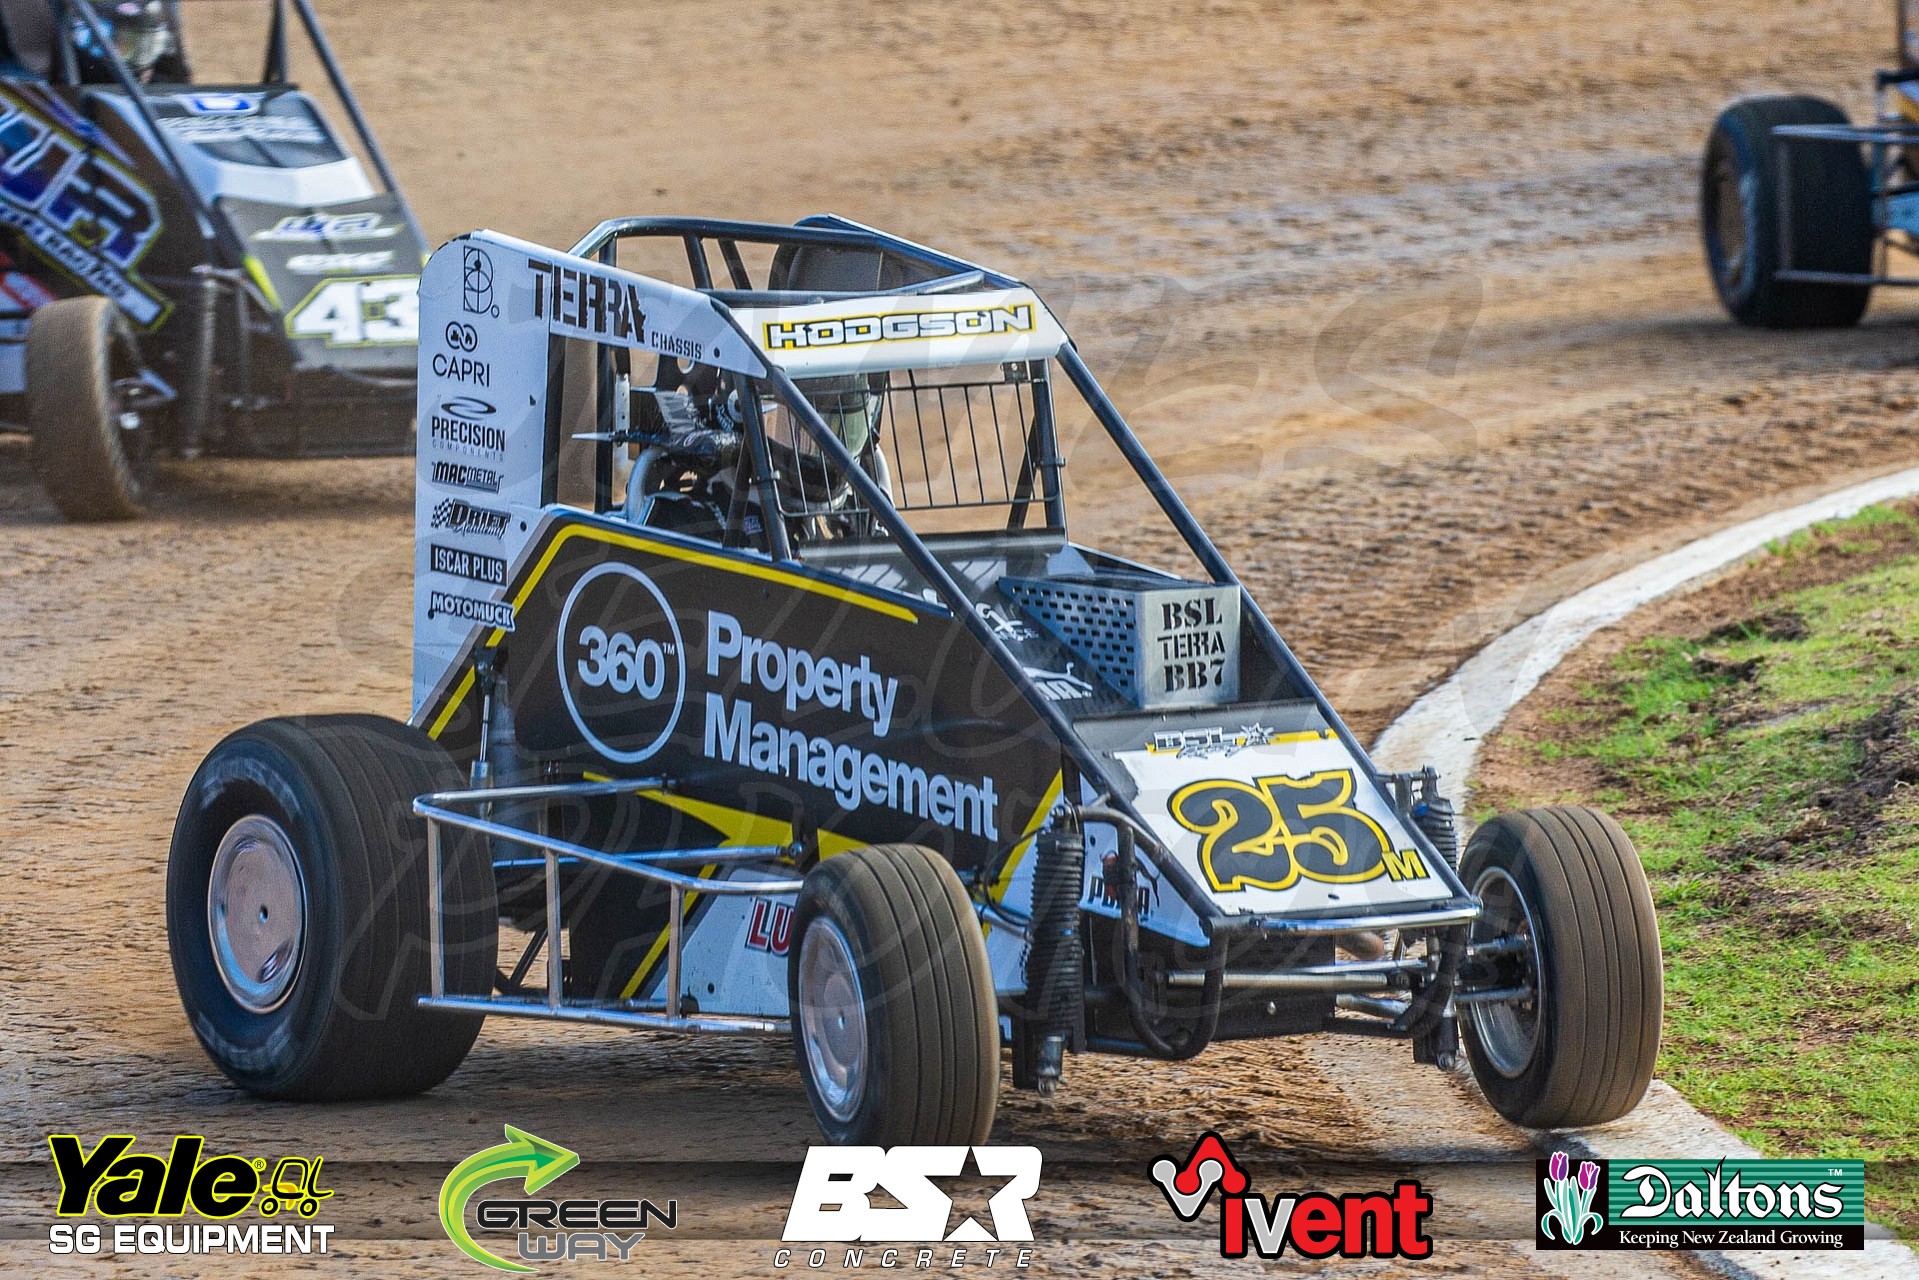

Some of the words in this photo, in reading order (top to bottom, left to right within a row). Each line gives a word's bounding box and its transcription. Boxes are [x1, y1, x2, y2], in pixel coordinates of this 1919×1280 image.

[287, 276, 419, 346] 43
[528, 258, 646, 343] TERRA
[651, 331, 703, 361] CHASSIS
[765, 304, 1034, 351] HODGSON
[432, 353, 491, 388] CAPRI
[431, 416, 506, 452] PRECISION
[435, 547, 470, 577] ISCAR
[473, 555, 504, 583] PLUS
[431, 591, 514, 629] MOTOMUCK
[1162, 597, 1223, 631] BSL
[577, 625, 666, 701] 360
[1157, 631, 1226, 660] TERRA
[707, 609, 899, 738] Property
[1163, 659, 1226, 693] BB7
[704, 691, 999, 843] Management
